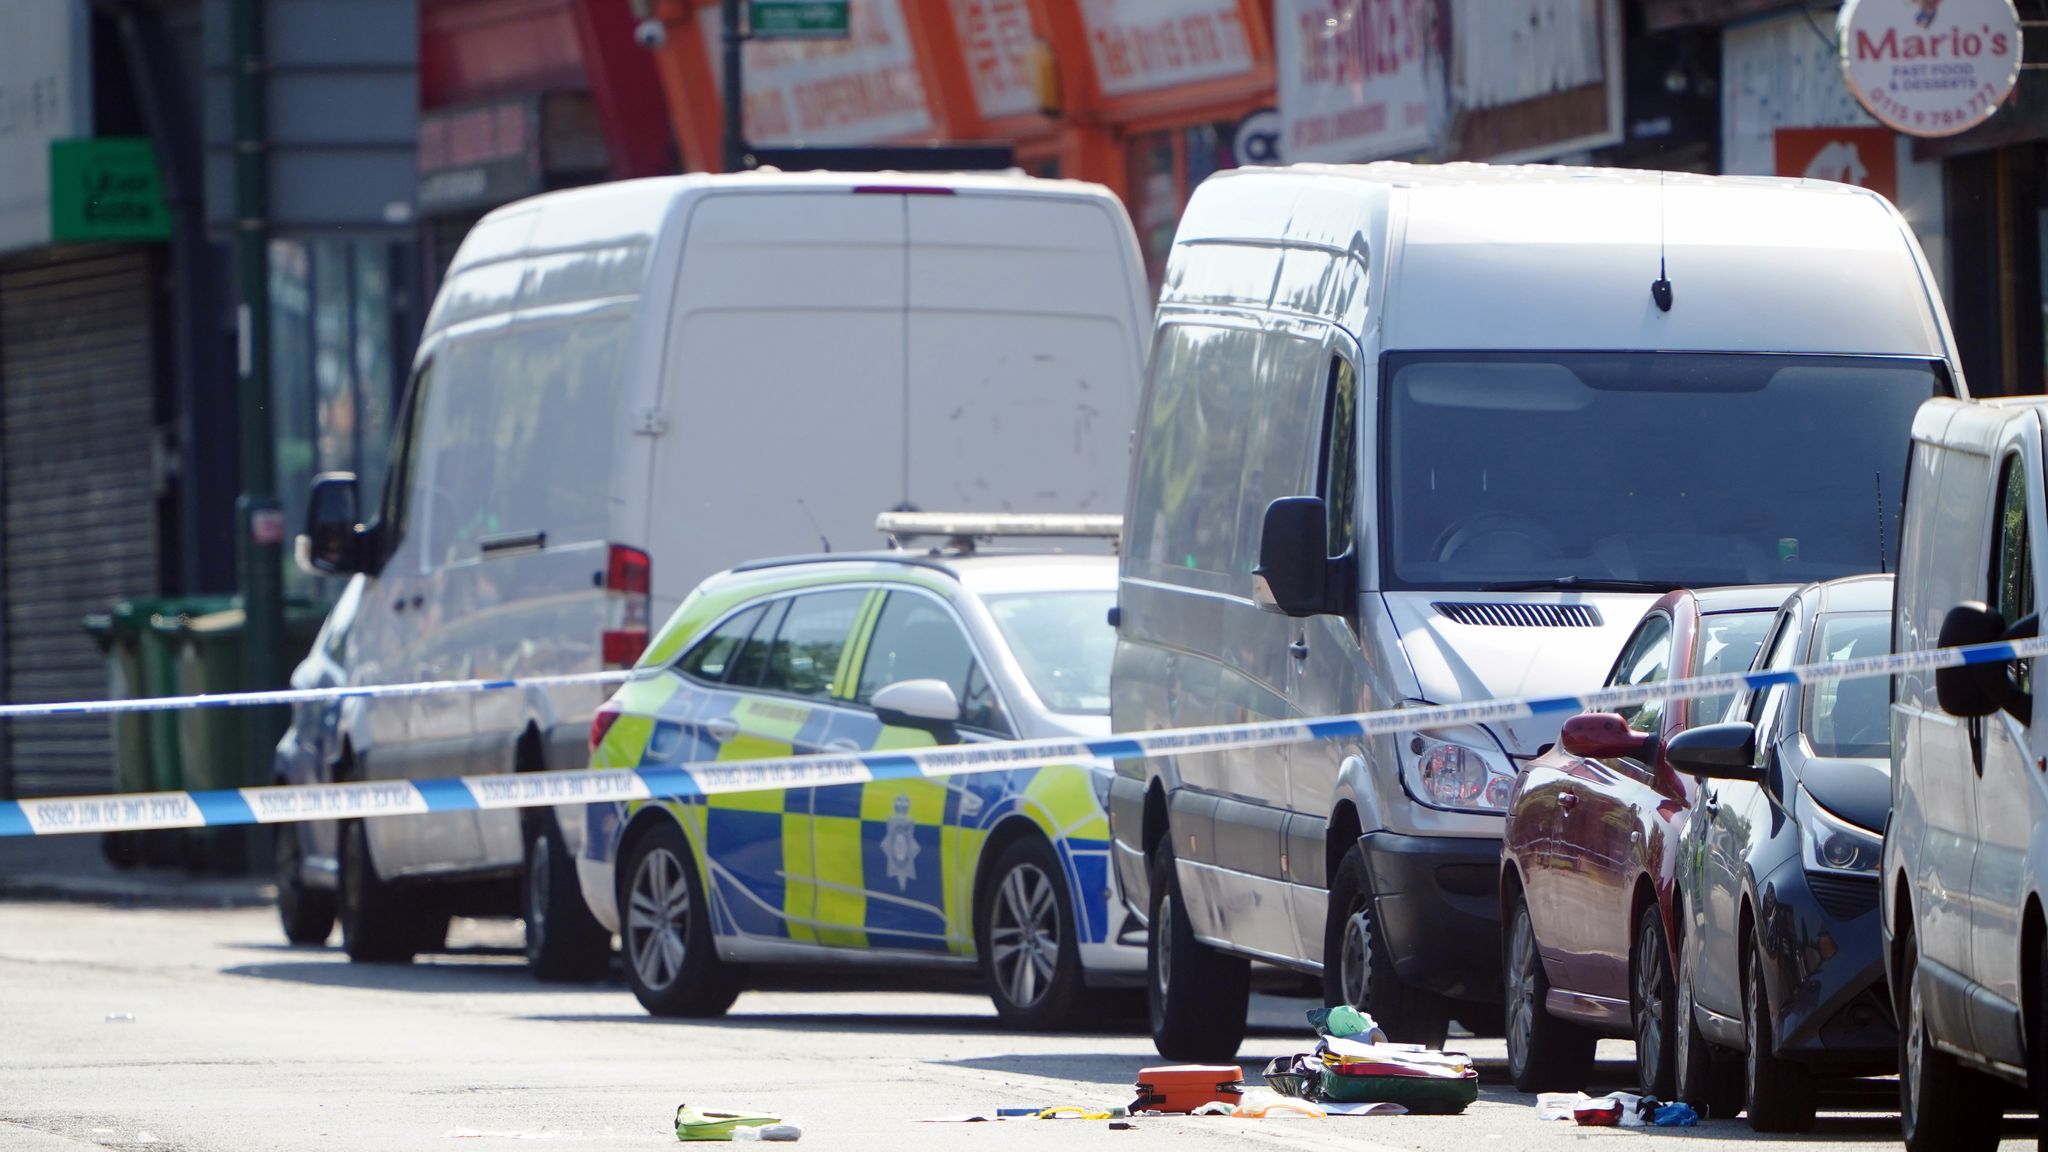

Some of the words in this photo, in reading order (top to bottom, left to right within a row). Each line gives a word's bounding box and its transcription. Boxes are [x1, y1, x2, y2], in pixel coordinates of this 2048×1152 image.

[1856, 24, 2008, 61] Mario's
[1892, 65, 1927, 77] FAST
[1931, 63, 1974, 76] FOOD
[1904, 78, 1977, 91] DESSERTS
